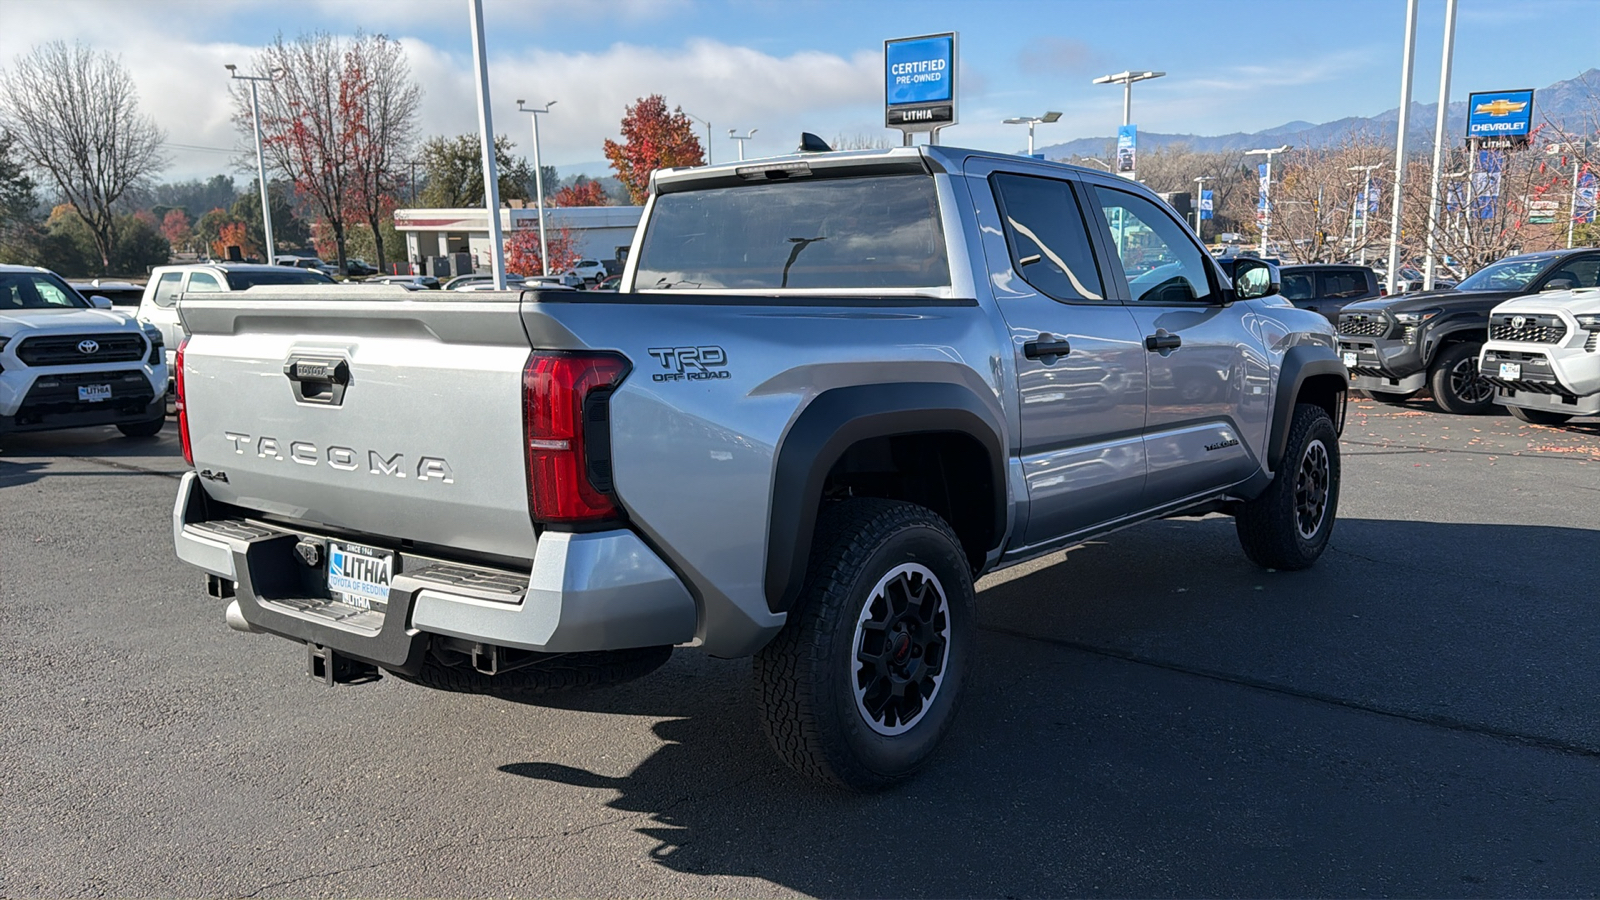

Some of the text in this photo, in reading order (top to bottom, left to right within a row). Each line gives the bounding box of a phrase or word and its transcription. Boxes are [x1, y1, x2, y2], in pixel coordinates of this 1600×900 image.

[891, 59, 946, 75] CERTIFIED
[896, 73, 941, 84] PRE-OWNED
[903, 110, 932, 120] LITHIA
[1471, 121, 1526, 132] CHEVROLET
[1482, 140, 1511, 149] LITHIA
[648, 345, 728, 373] TRD
[652, 370, 732, 382] OFF ROAD
[224, 430, 455, 484] TACOMA
[346, 544, 361, 554] SINCE
[343, 555, 389, 587] LITHIA
[330, 575, 352, 588] TOYOTA
[352, 580, 361, 590] OF
